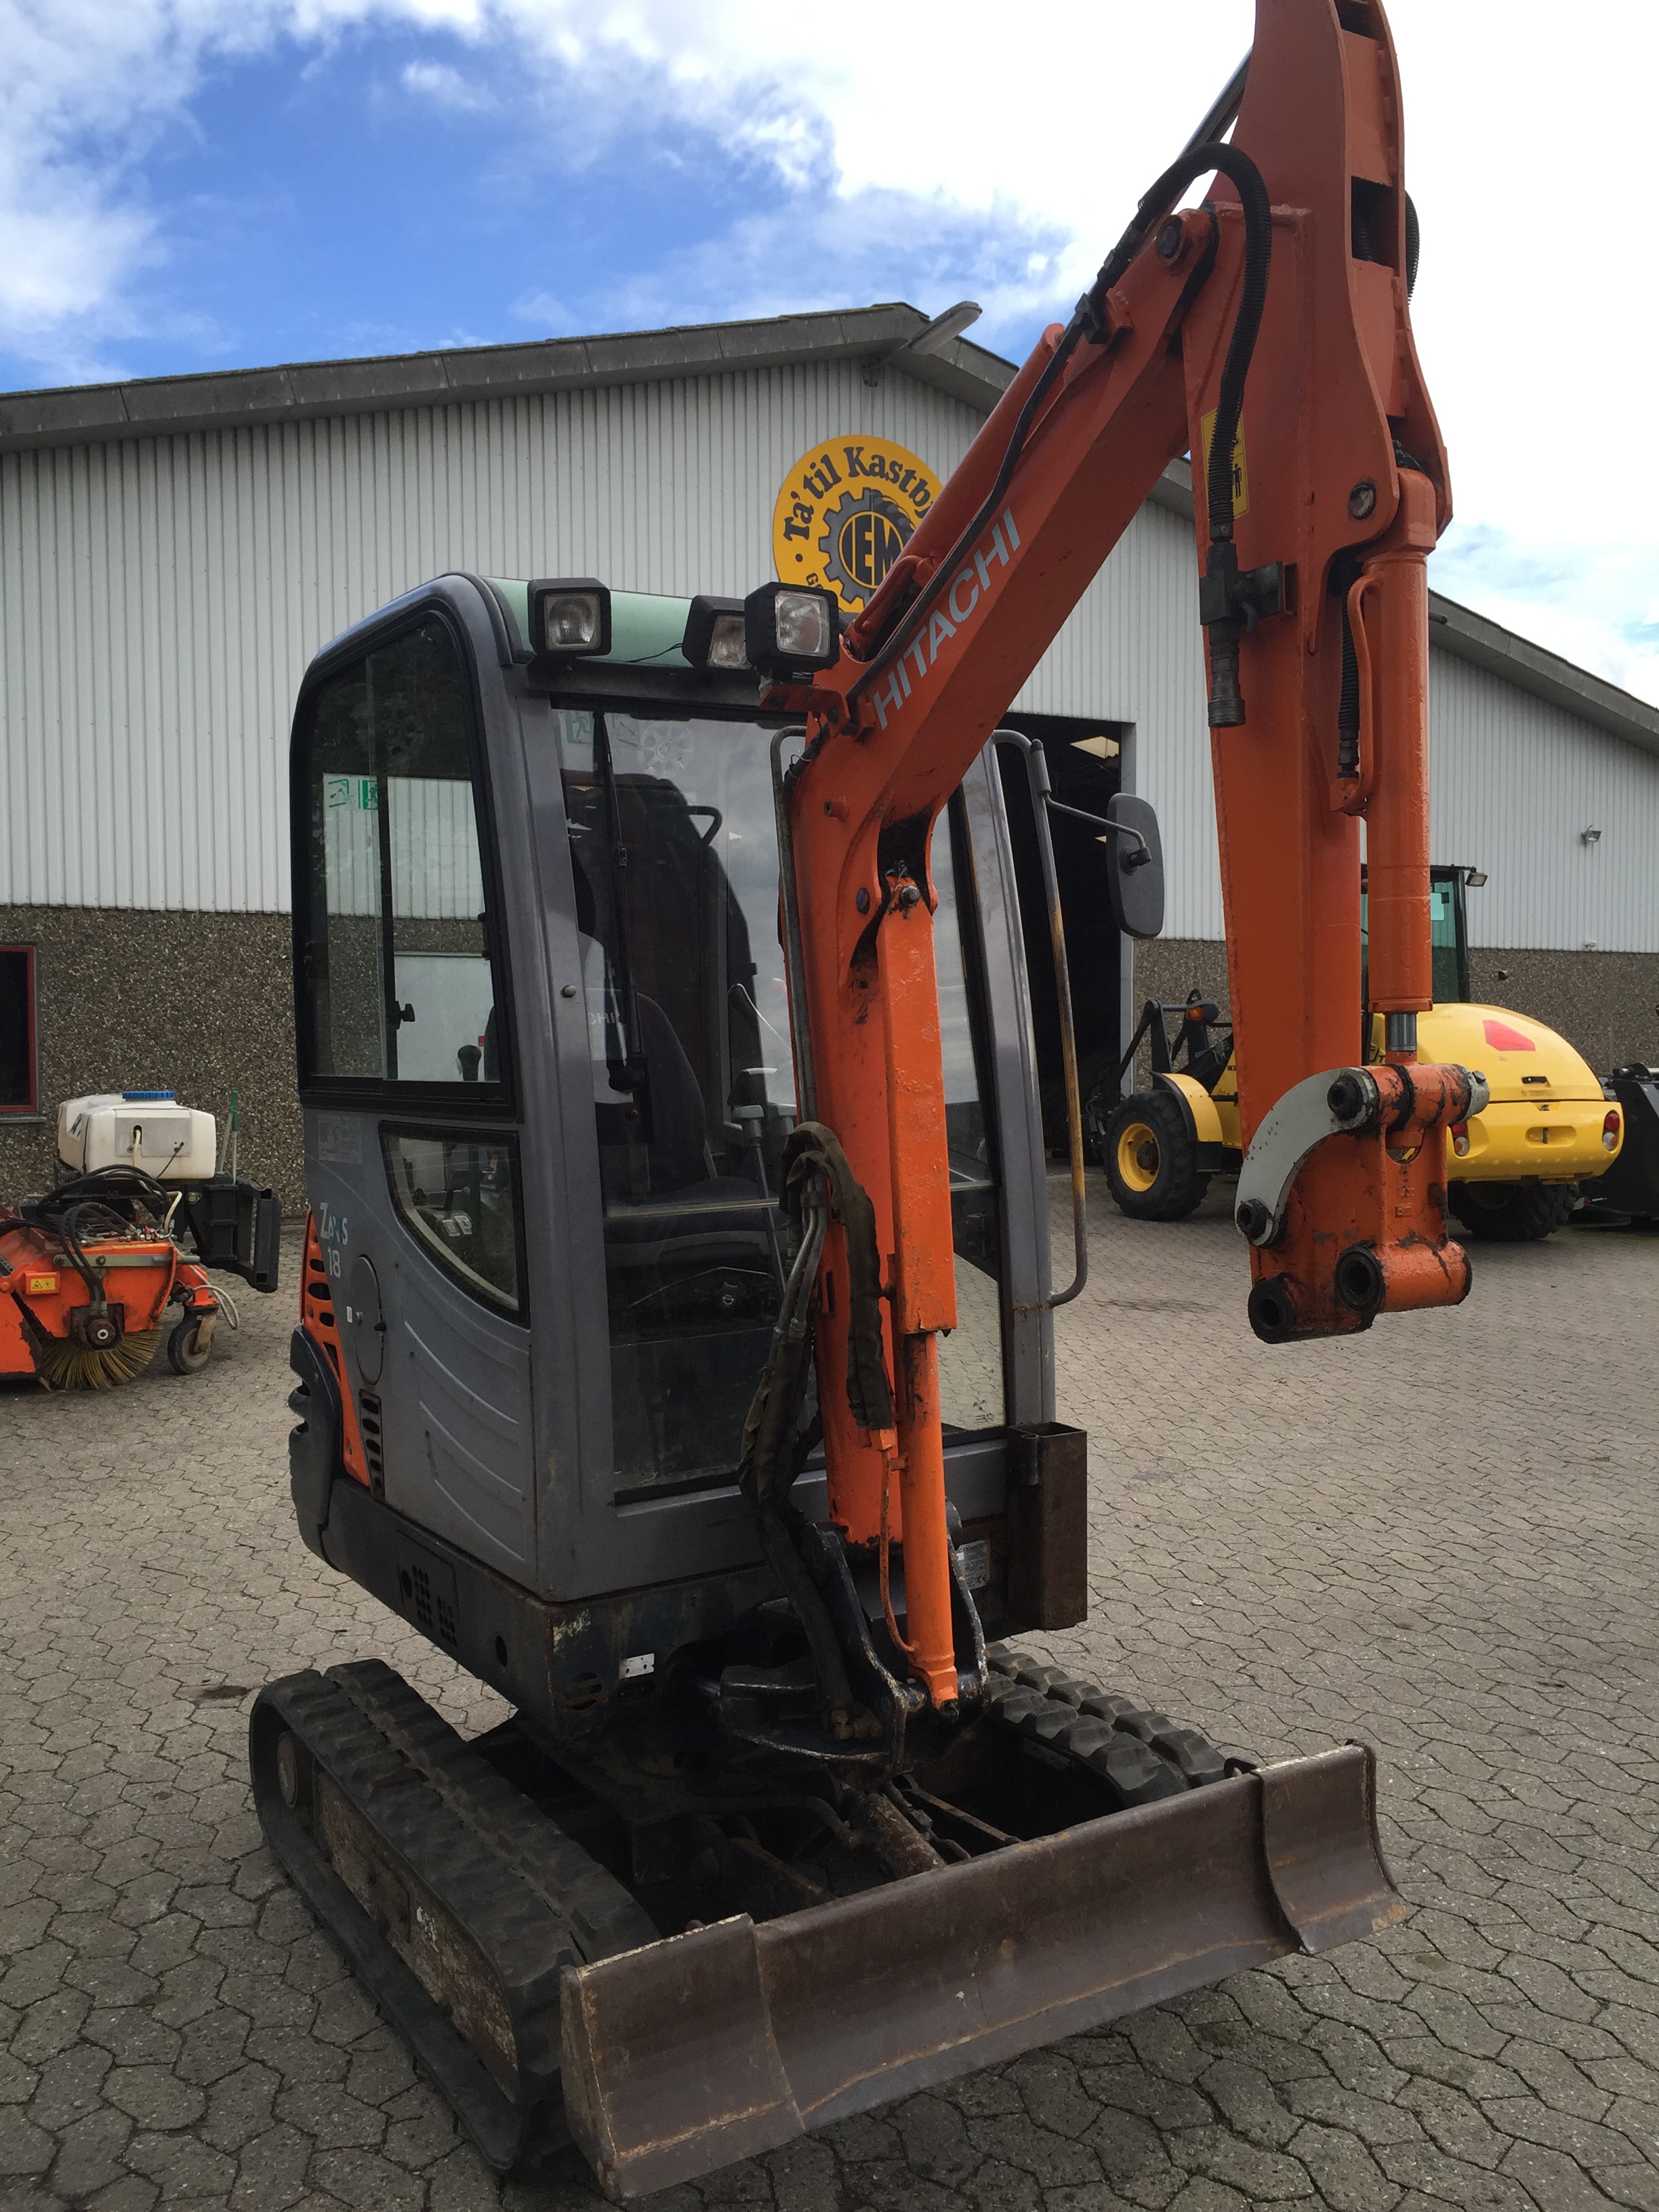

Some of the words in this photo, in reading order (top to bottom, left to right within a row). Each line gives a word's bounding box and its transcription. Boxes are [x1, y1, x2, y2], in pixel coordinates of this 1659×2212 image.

[802, 453, 842, 500] til
[874, 507, 1021, 731] HITACHI
[327, 1246, 342, 1279] 18
